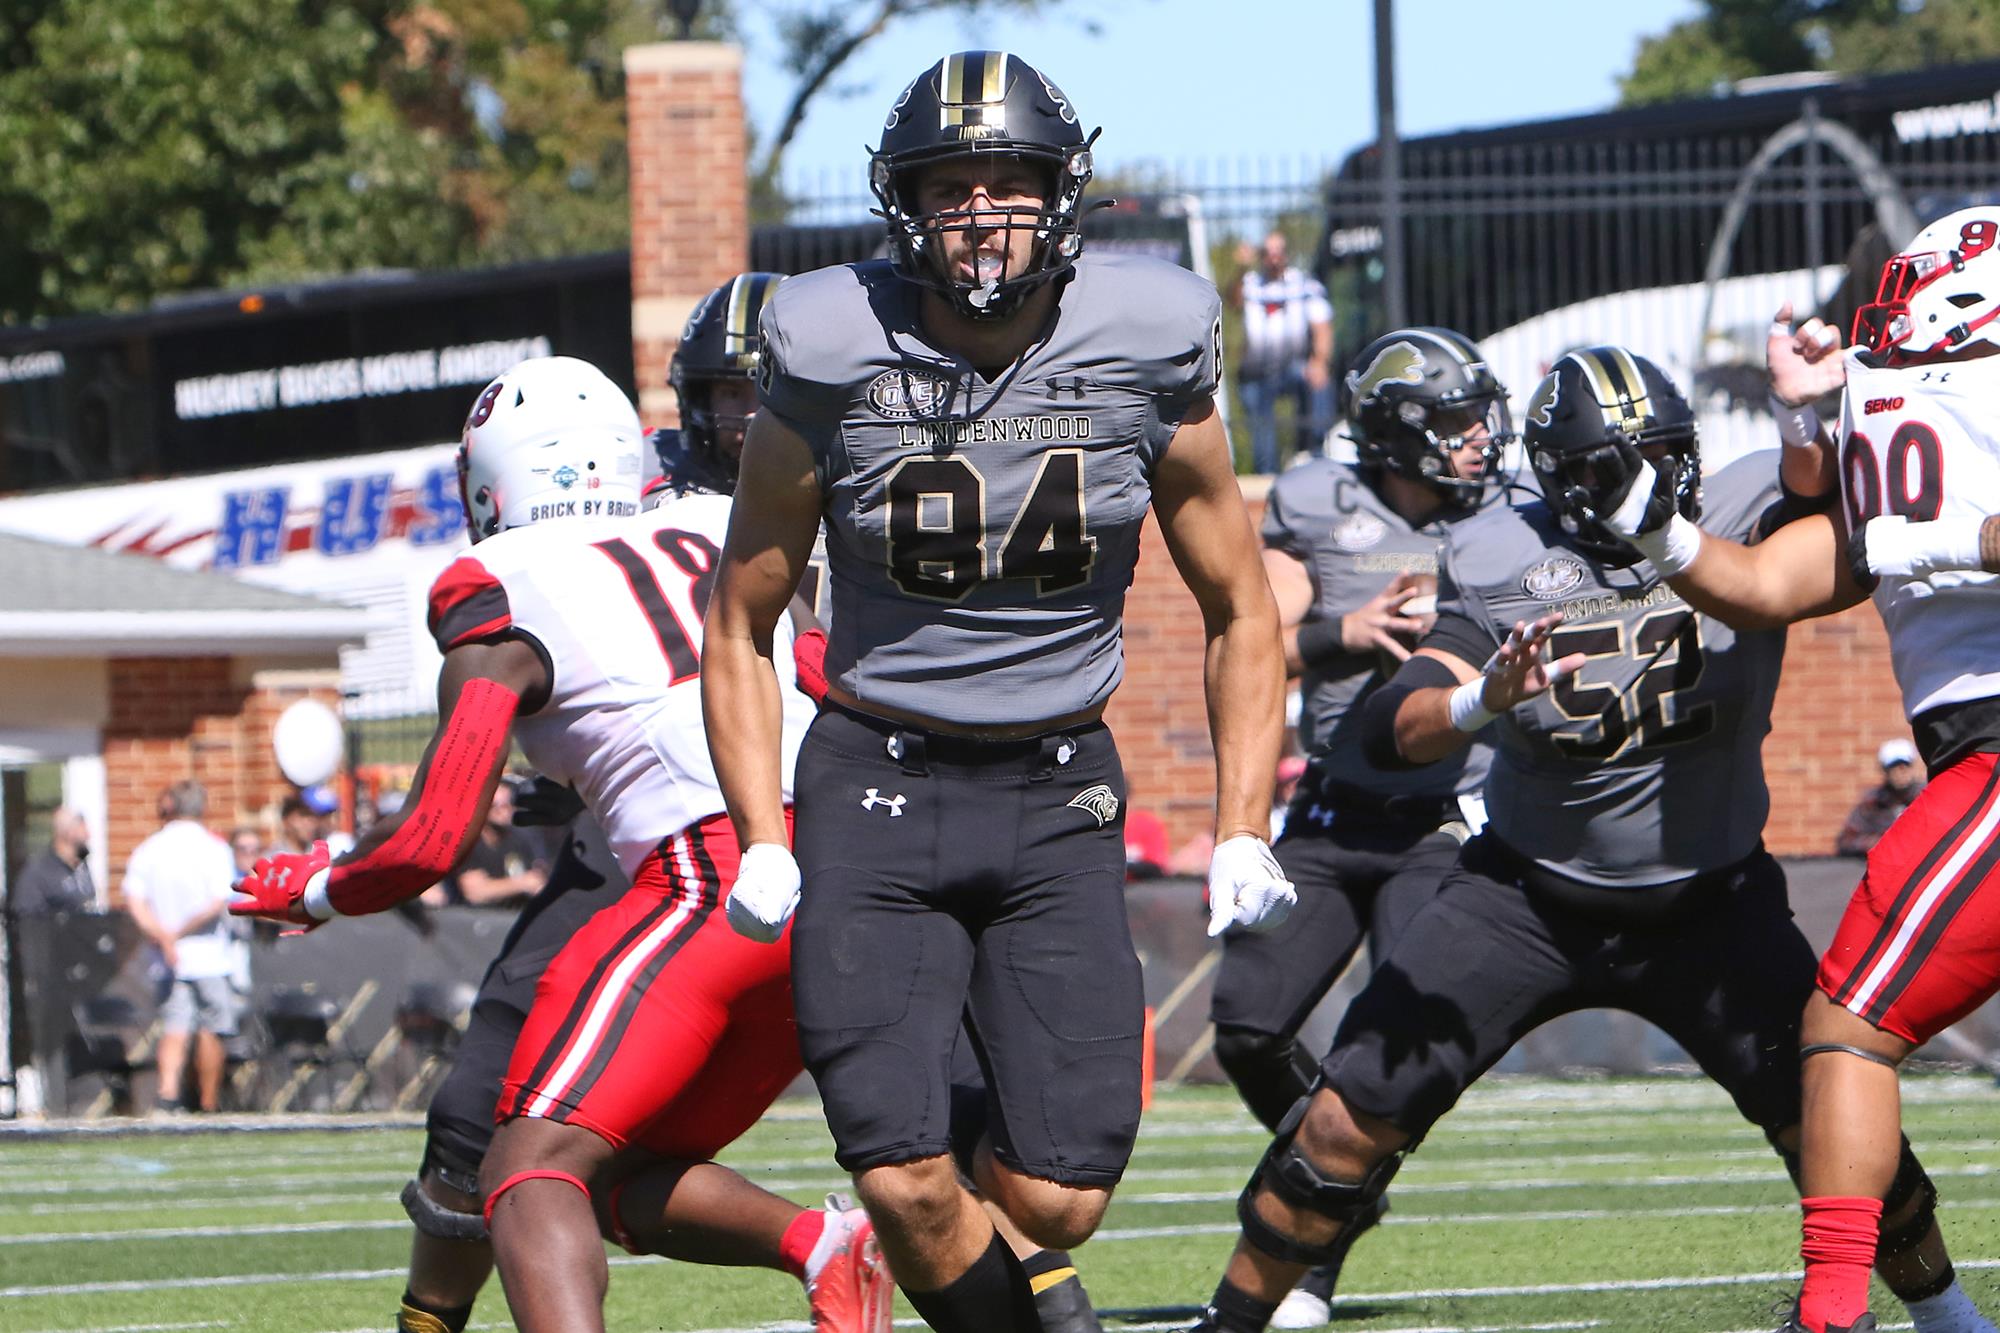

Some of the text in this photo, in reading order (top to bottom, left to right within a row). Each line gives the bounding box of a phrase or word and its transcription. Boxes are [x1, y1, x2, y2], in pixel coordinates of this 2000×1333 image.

[174, 367, 278, 420] HUSKEY
[278, 357, 363, 408] BUSES
[361, 348, 437, 397] MOVE
[883, 379, 934, 406] OVC
[1864, 396, 1905, 416] SEMO
[897, 415, 1093, 449] LINDENWOOD
[531, 501, 577, 522] BRICK
[583, 500, 602, 516] BY
[1334, 478, 1359, 515] C
[884, 447, 1098, 604] 84
[1547, 603, 1717, 764] 52
